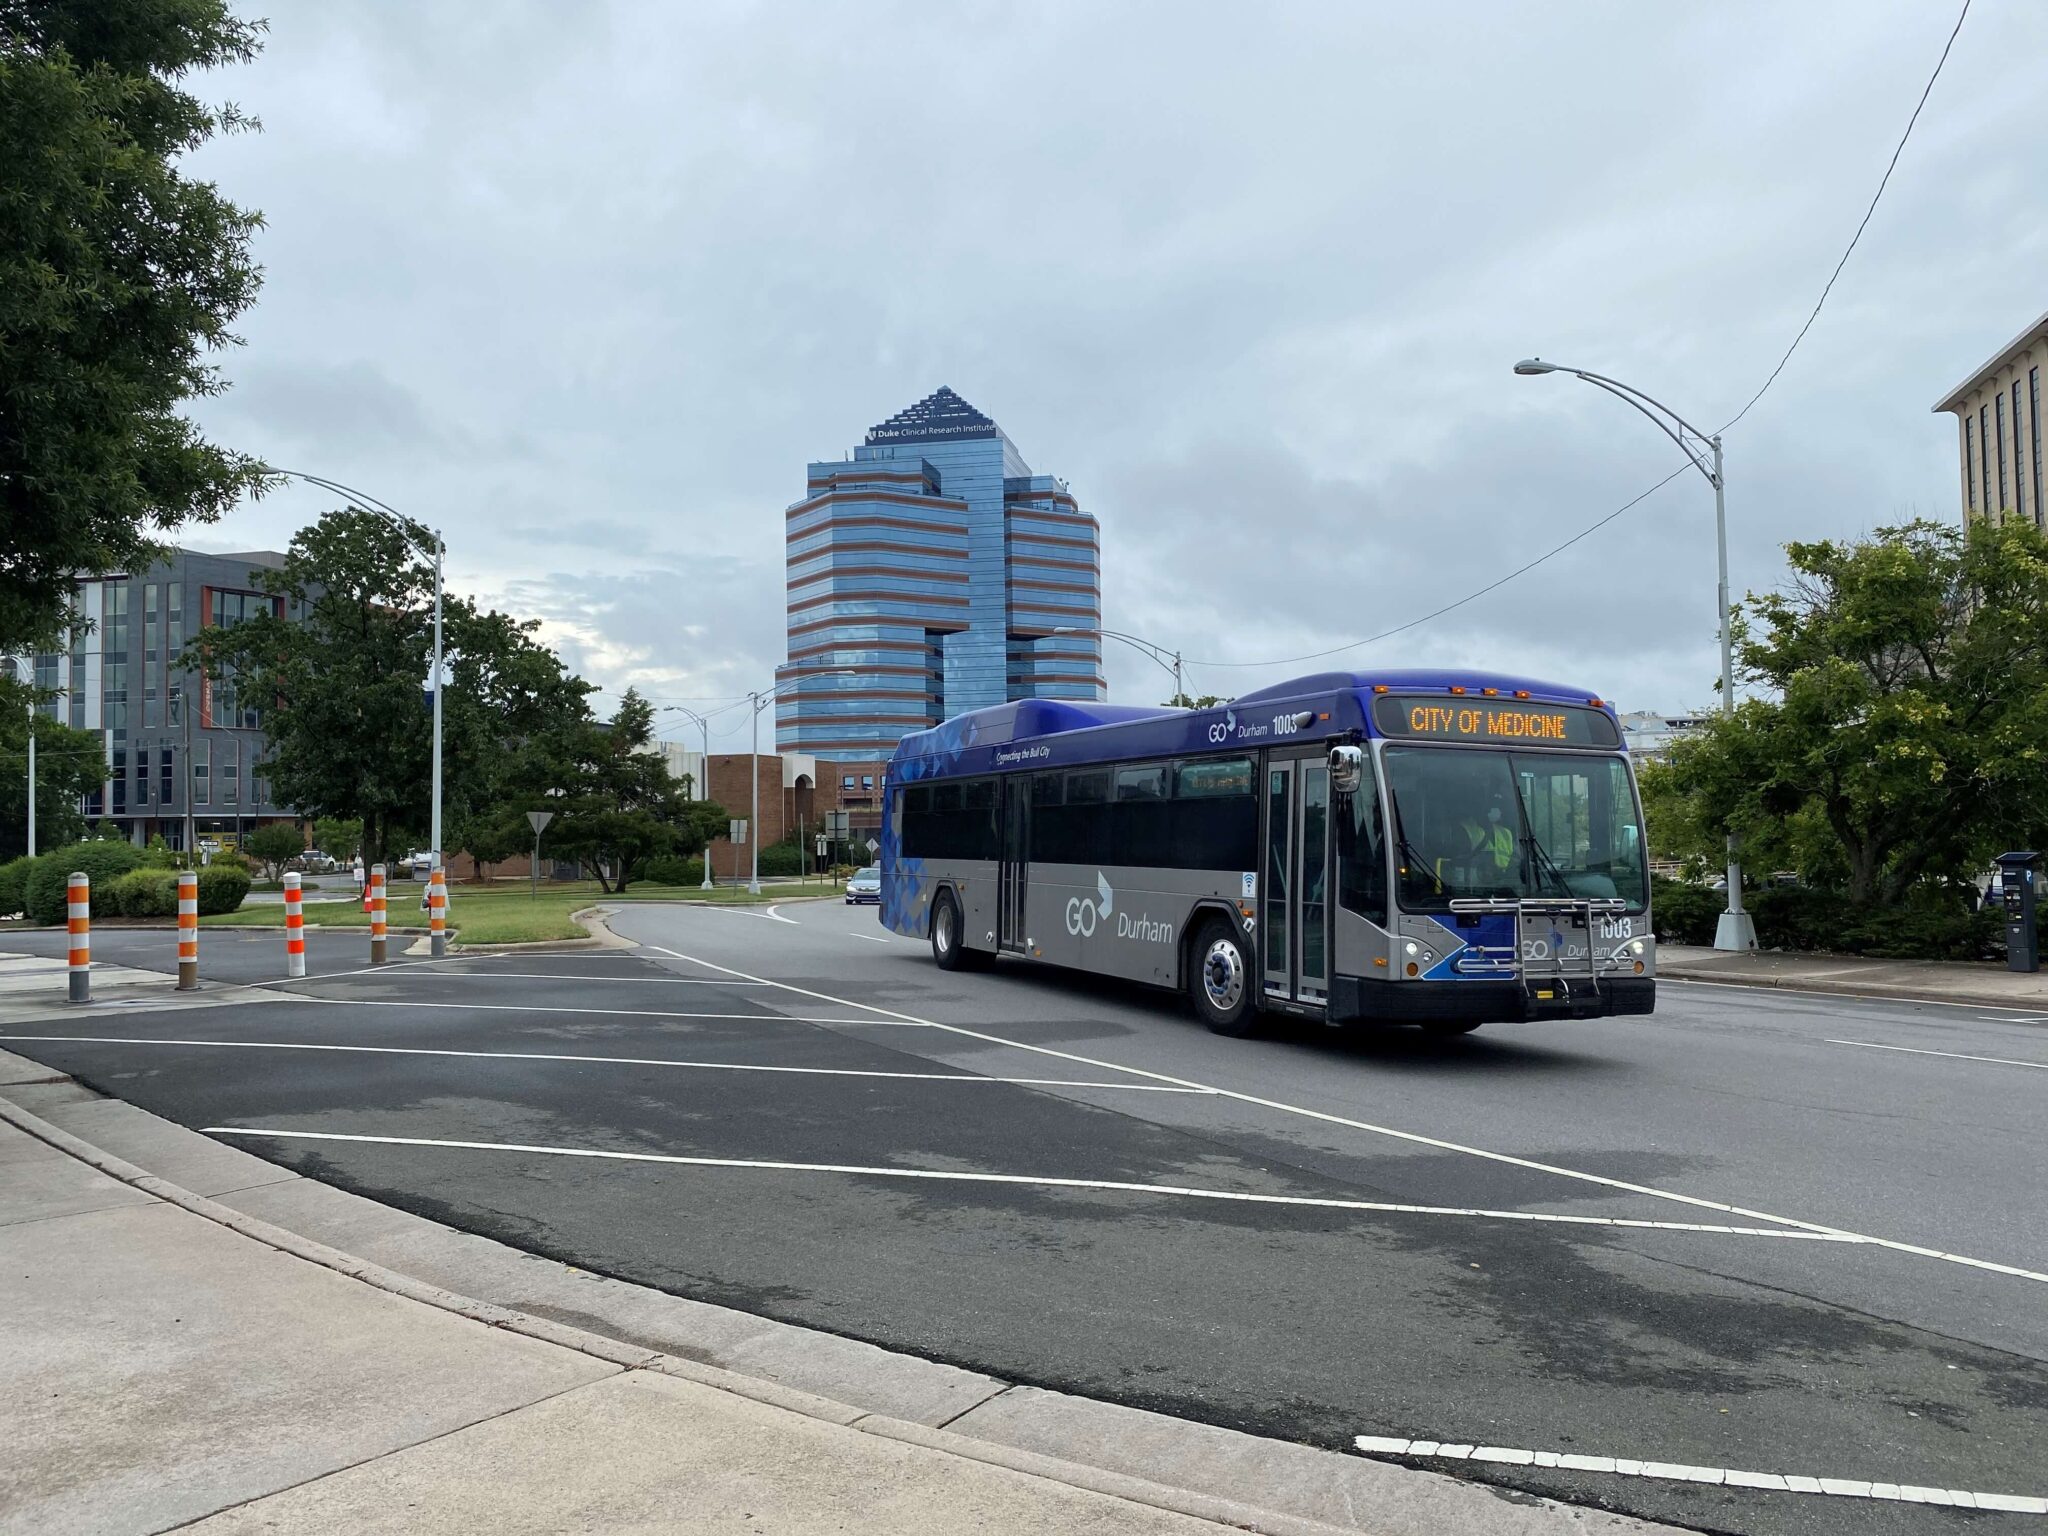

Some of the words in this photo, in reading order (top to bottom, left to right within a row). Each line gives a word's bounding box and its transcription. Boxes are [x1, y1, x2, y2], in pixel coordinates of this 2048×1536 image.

[878, 430, 899, 438] Duke
[901, 427, 927, 437] Clinical
[929, 425, 961, 434] Research
[963, 423, 994, 432] Institute
[1208, 723, 1227, 743] GO
[1238, 724, 1268, 738] Durham
[1273, 714, 1298, 735] 1003
[1411, 707, 1453, 732] CITY
[1458, 710, 1482, 734] OF
[1488, 712, 1567, 738] MEDICINE
[1021, 749, 1030, 759] the
[1030, 748, 1040, 758] Bull
[1040, 746, 1050, 759] City
[1065, 897, 1096, 937] GO
[1118, 912, 1172, 943] Durham
[1600, 917, 1632, 939] 1003
